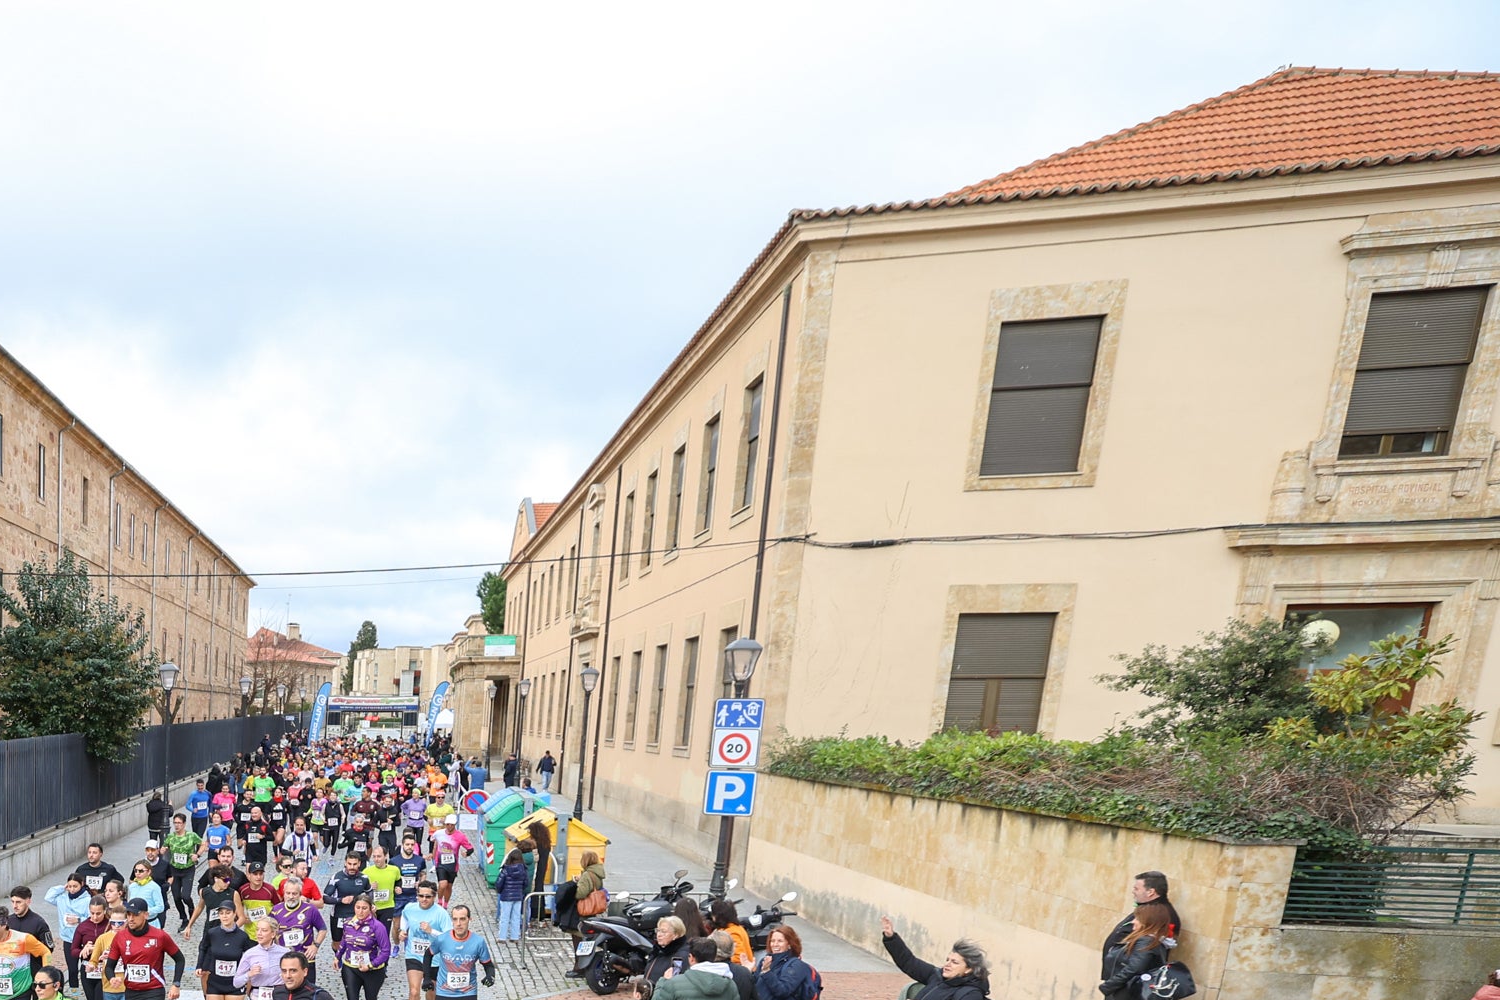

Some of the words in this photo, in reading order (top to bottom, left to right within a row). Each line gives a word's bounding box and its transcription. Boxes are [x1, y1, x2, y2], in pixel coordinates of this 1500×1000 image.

[726, 743, 743, 753] 20
[712, 775, 746, 810] P
[131, 968, 147, 977] 143
